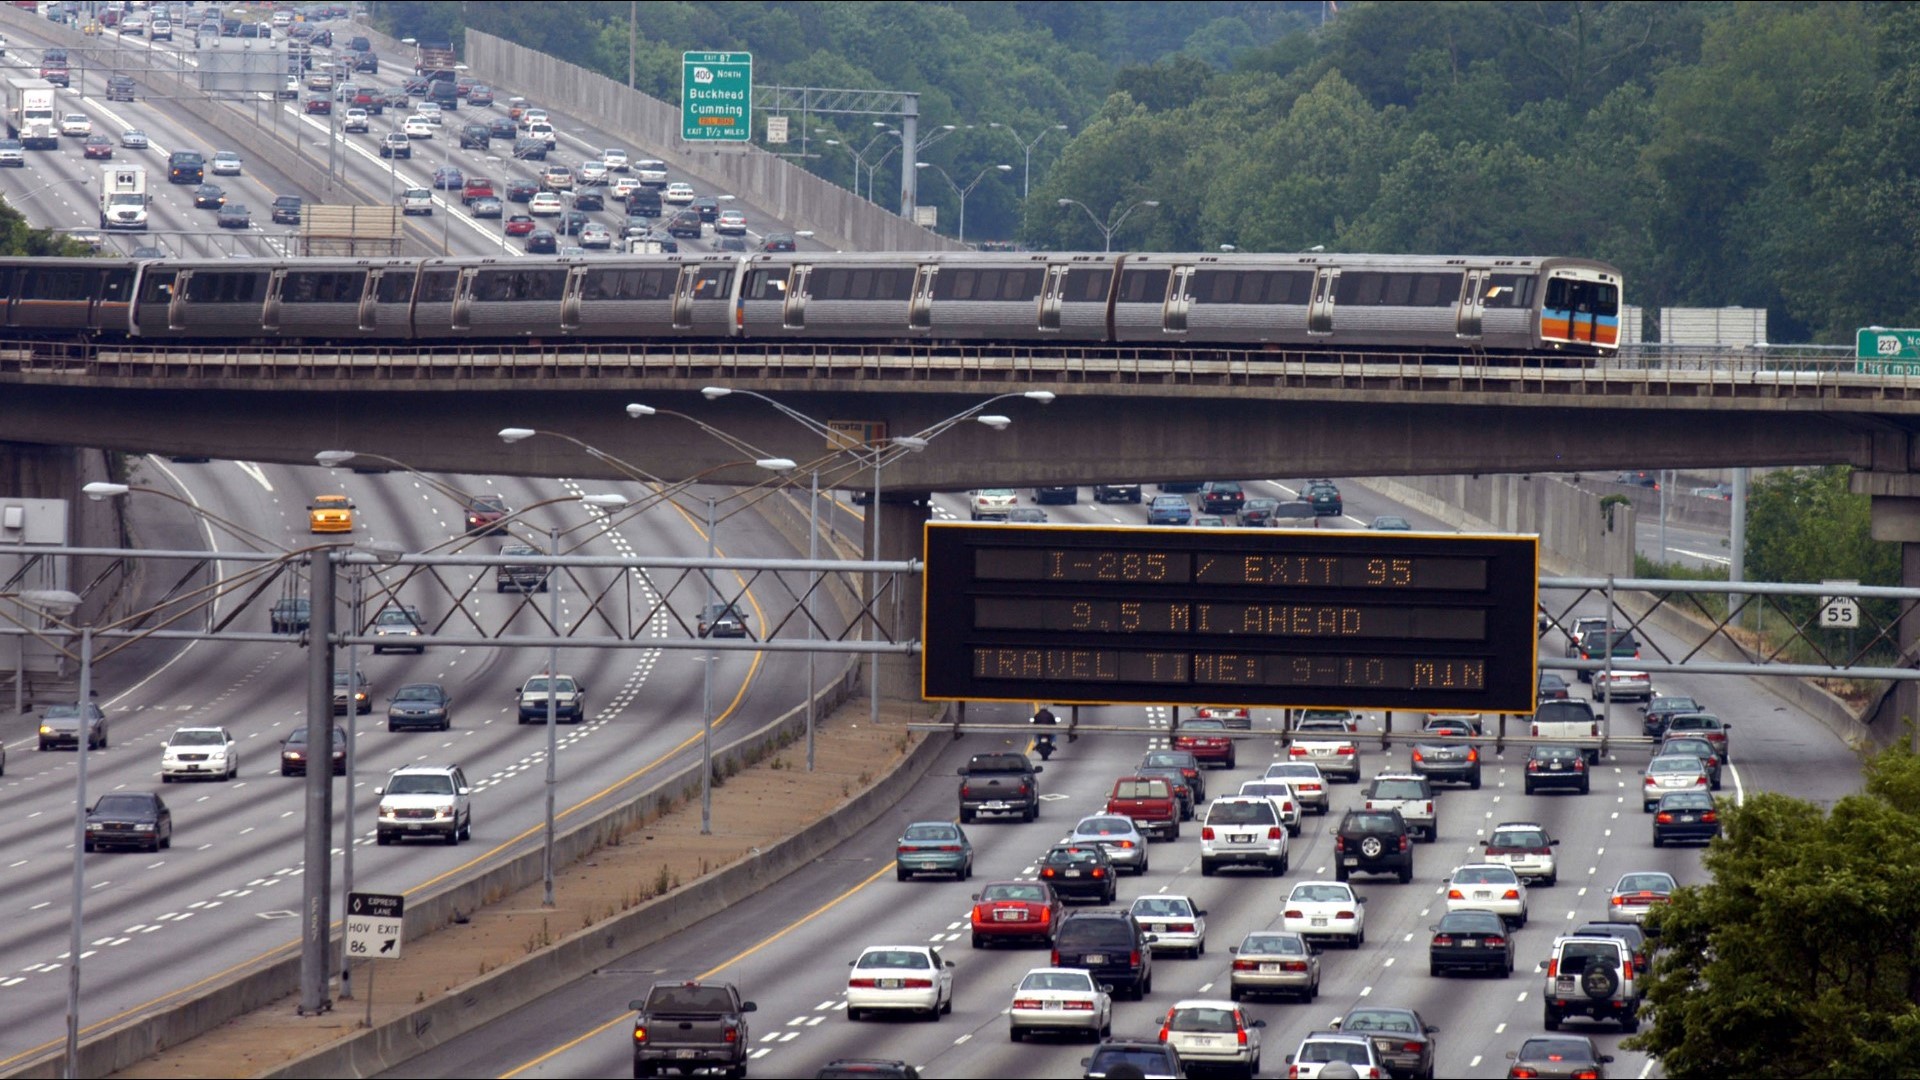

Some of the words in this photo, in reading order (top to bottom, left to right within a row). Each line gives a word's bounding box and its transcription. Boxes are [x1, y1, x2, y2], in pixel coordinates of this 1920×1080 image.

[695, 70, 711, 80] 400
[717, 70, 741, 78] NORTH
[690, 88, 744, 99] Buckhead
[690, 104, 743, 117] Cumming
[687, 127, 702, 135] EXIT
[724, 128, 745, 136] MILES
[1879, 340, 1898, 352] 237
[1052, 552, 1166, 580] I-285
[1244, 556, 1338, 584] EXIT
[1367, 558, 1412, 586] 95
[1072, 601, 1142, 630] 9.5
[1244, 605, 1361, 635] AHEAD
[1827, 606, 1853, 622] 55
[973, 649, 1116, 679] TRAVEL
[1145, 652, 1256, 682] TIME:
[1292, 656, 1385, 686] 9-10
[1414, 662, 1484, 688] MIN
[367, 897, 398, 908] EXPRESS
[373, 907, 392, 916] LANE
[348, 922, 370, 933] HOV
[377, 924, 399, 935] EXIT
[350, 940, 367, 953] 86
